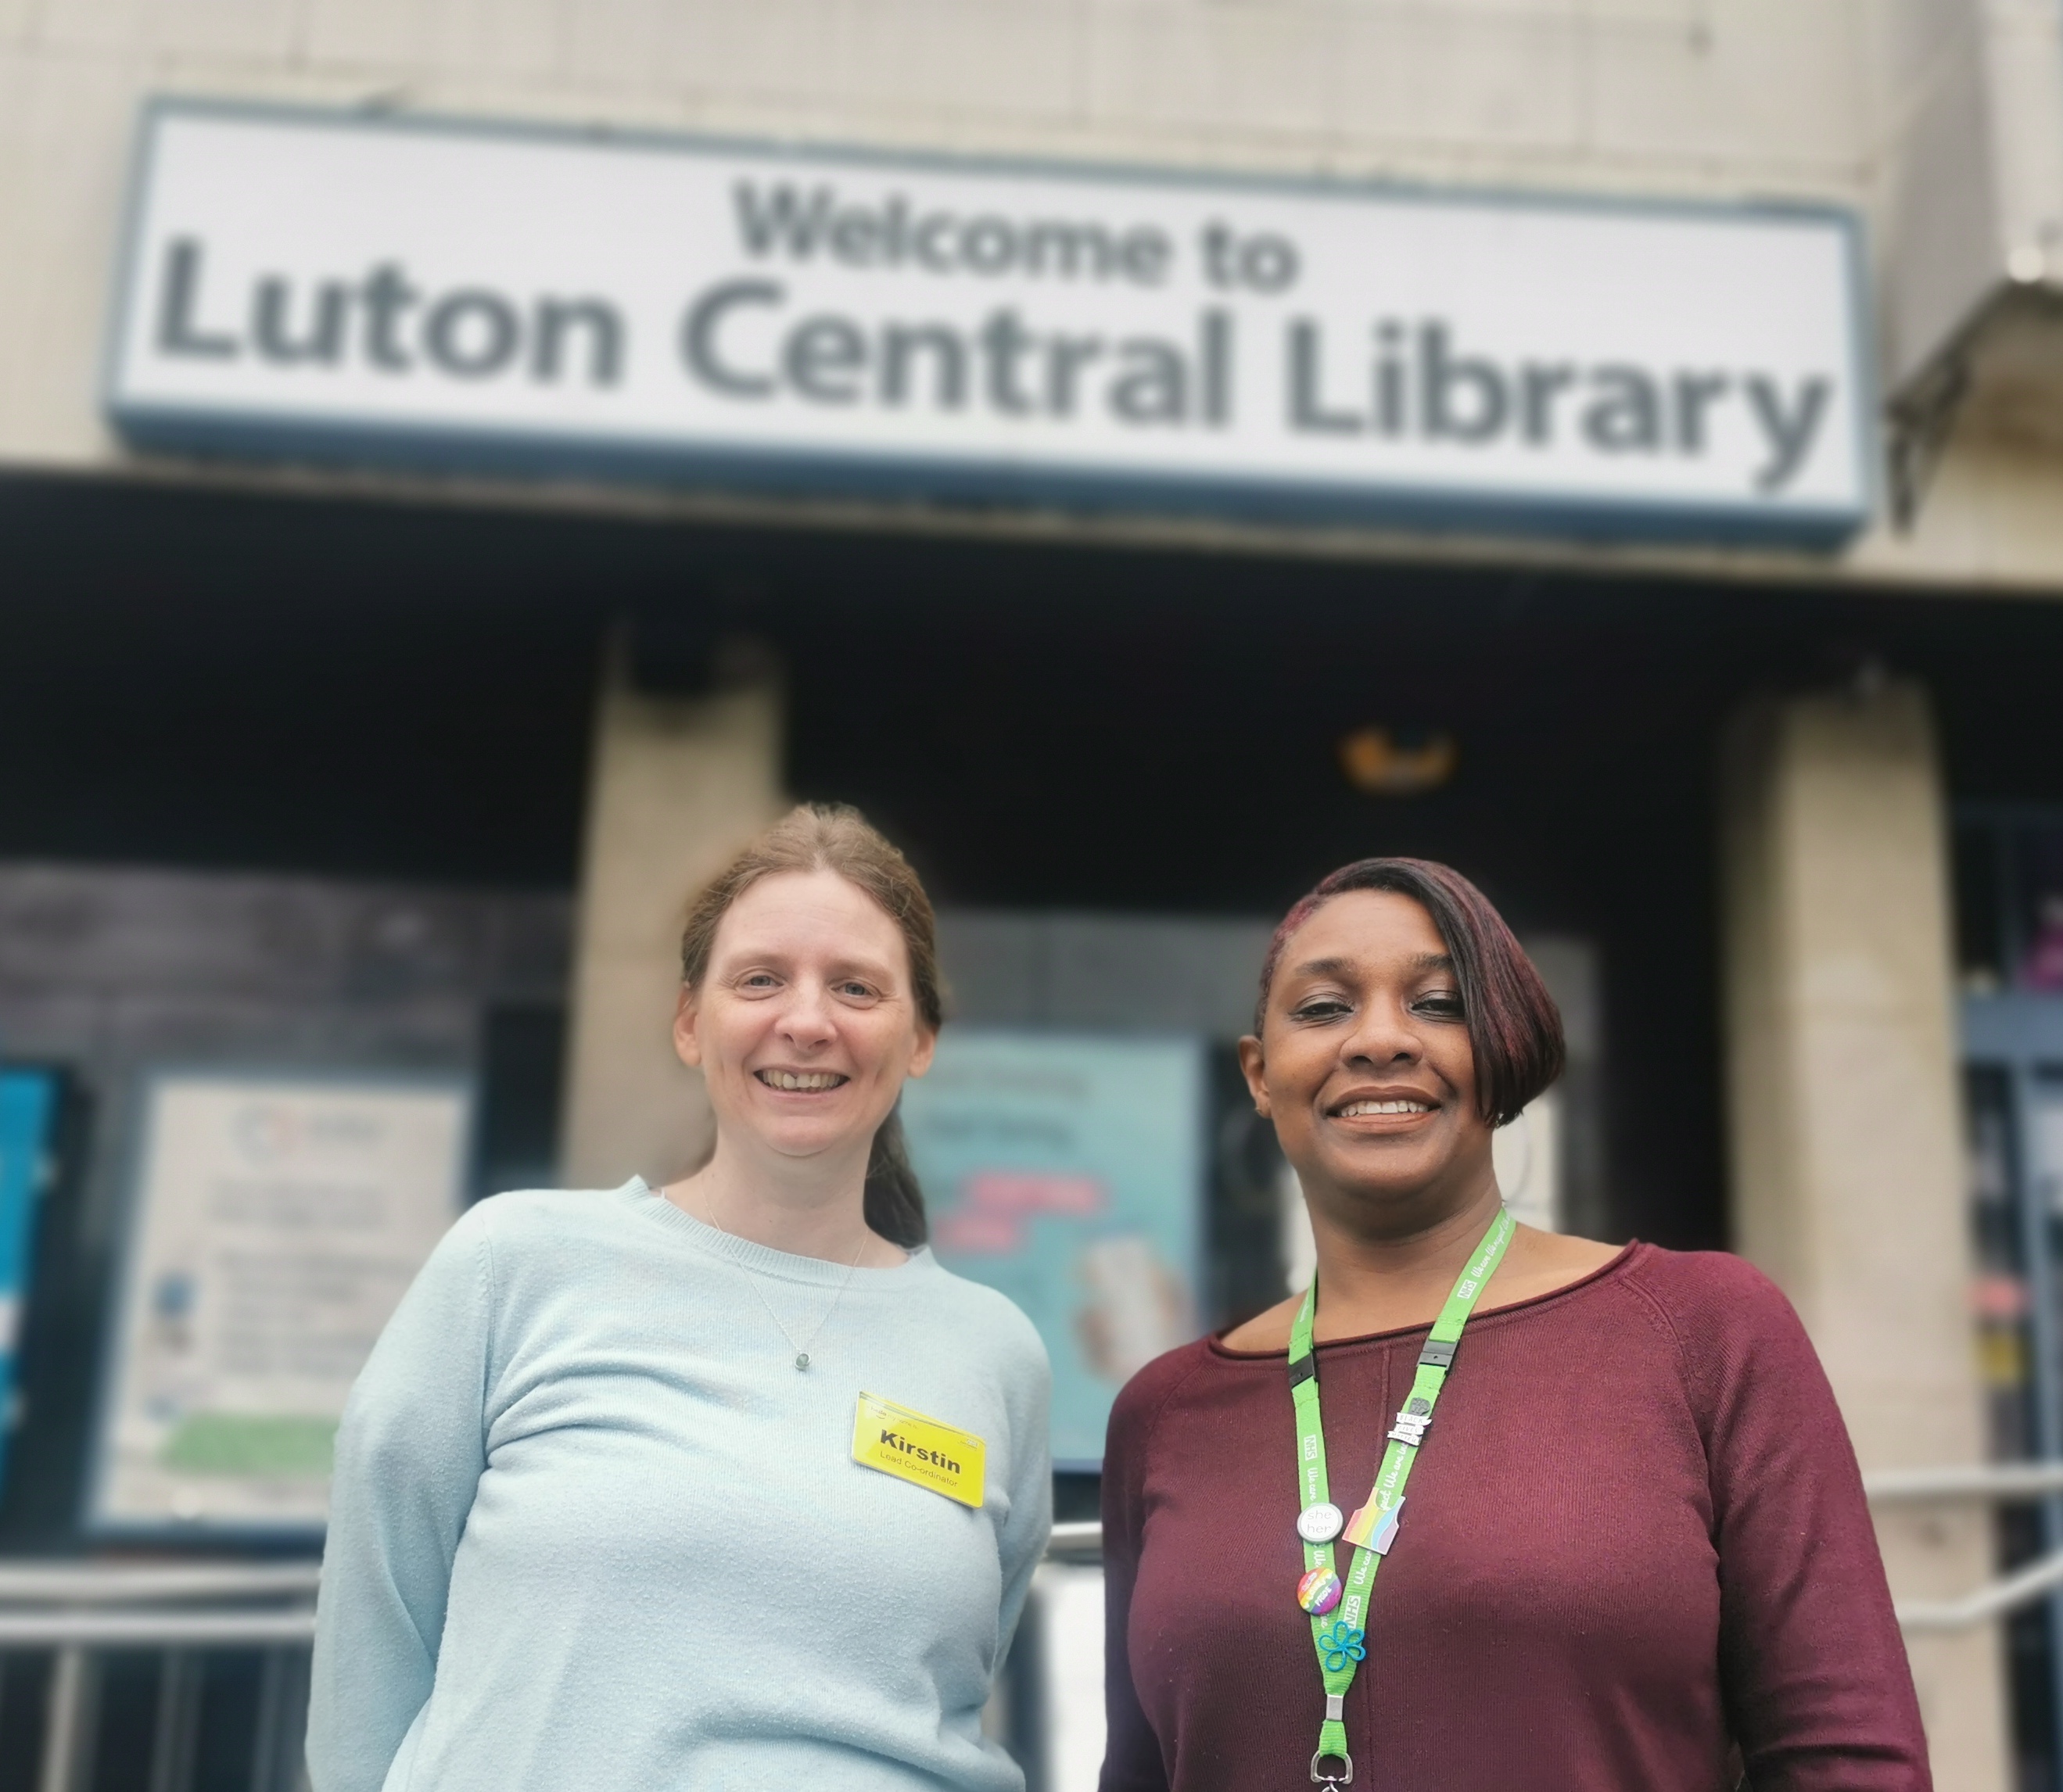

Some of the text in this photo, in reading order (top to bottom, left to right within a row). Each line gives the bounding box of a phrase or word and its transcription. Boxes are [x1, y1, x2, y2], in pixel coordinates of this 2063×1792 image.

[731, 177, 1301, 296] Welcome to
[154, 235, 1833, 494] Luton Central Library
[1458, 1281, 1476, 1299] NHS
[1471, 1267, 1484, 1278] We
[1400, 1414, 1423, 1424] BLACK
[880, 1429, 960, 1475] Kirstin
[880, 1451, 958, 1487] Lead Co-ordinator
[1305, 1436, 1319, 1500] NHS We care
[1307, 1524, 1331, 1534] her
[1308, 1511, 1332, 1520] she
[1345, 1596, 1360, 1629] NHS
[1353, 1566, 1367, 1585] We
[1363, 1550, 1372, 1565] car
[1383, 1471, 1398, 1488] We
[1394, 1456, 1404, 1471] are
[1315, 1586, 1333, 1607] PRIDE
